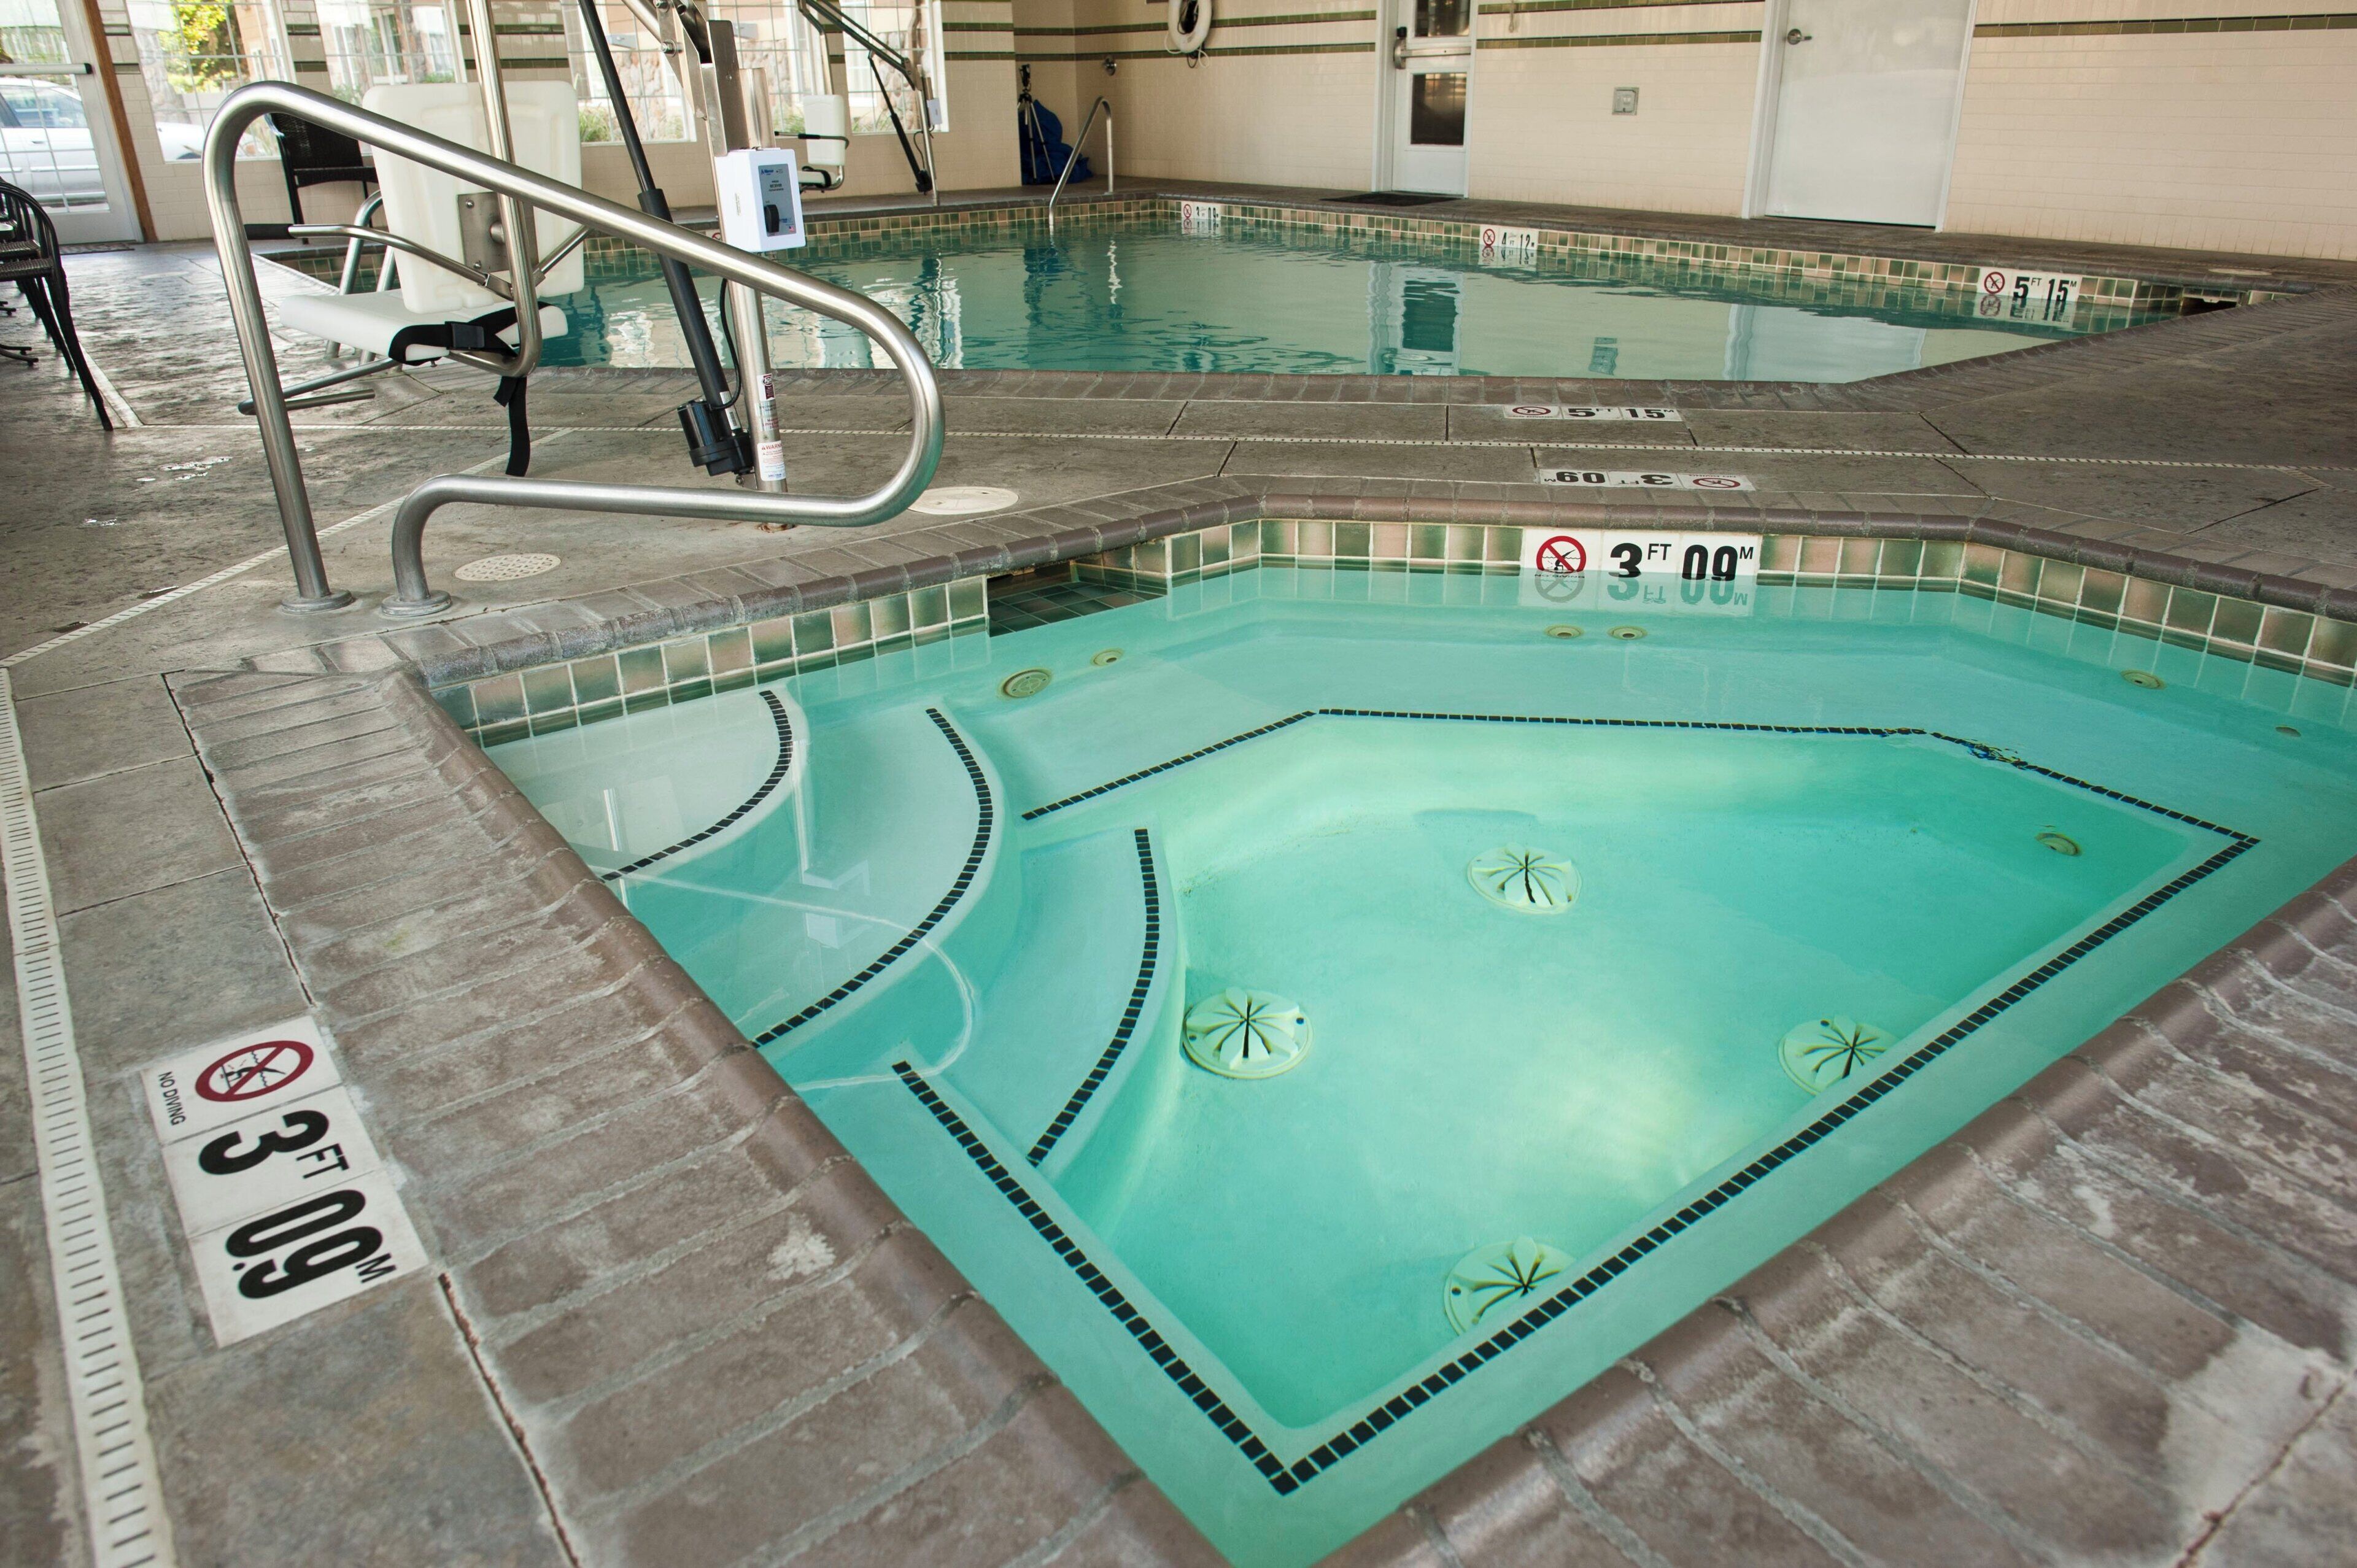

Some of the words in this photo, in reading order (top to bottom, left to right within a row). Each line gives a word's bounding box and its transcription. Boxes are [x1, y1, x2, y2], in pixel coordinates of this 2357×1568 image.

[2013, 276, 2030, 298] 5
[2031, 277, 2042, 287] FT
[1568, 408, 1596, 417] 5
[1640, 474, 1673, 485] 3
[1608, 543, 1643, 578] 3
[1647, 543, 1672, 561] FT
[1739, 546, 1754, 560] M
[158, 1071, 176, 1088] NO
[163, 1088, 187, 1126] DIVING
[198, 1110, 330, 1175] 3
[295, 1143, 350, 1180] FT
[226, 1189, 383, 1299] 0.9
[354, 1252, 397, 1284] M
